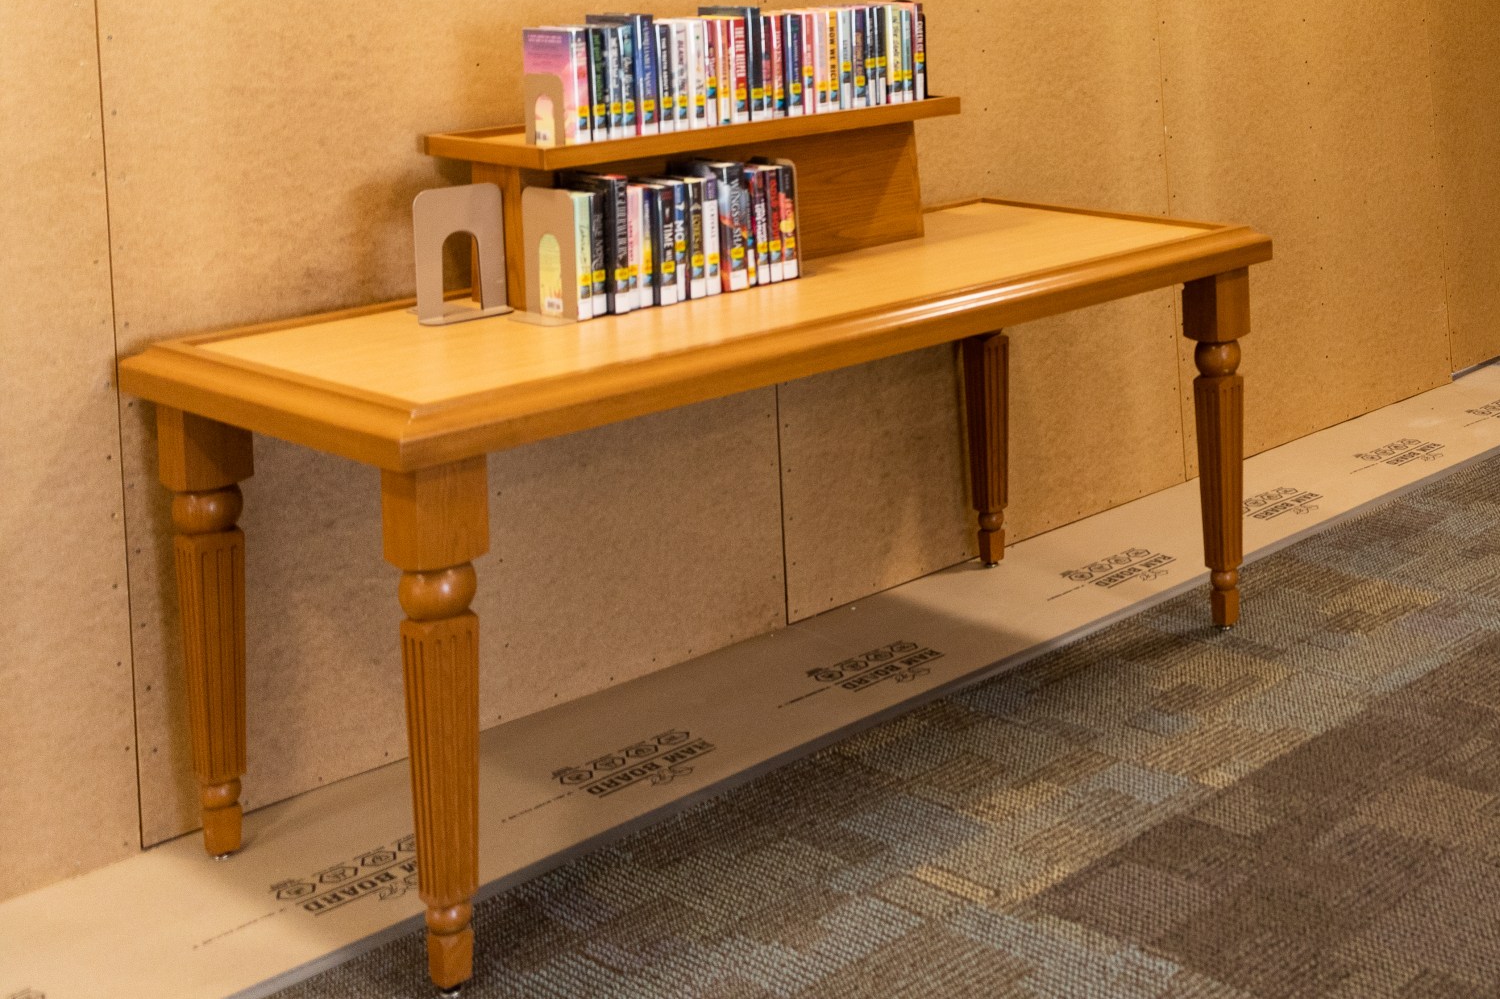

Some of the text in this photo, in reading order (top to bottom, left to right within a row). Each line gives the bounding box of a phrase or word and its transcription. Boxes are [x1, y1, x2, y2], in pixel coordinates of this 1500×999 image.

[829, 48, 836, 61] WE
[662, 71, 670, 90] ABOUT
[729, 178, 742, 217] WINGS
[663, 223, 674, 248] TIME
[1386, 451, 1420, 466] BOARD
[1252, 502, 1294, 519] BOARD
[1094, 554, 1172, 588] RAM BOARD
[841, 649, 942, 691] RAM BOARD
[586, 740, 714, 797] RAM BOARD
[302, 870, 397, 913] BOARD
